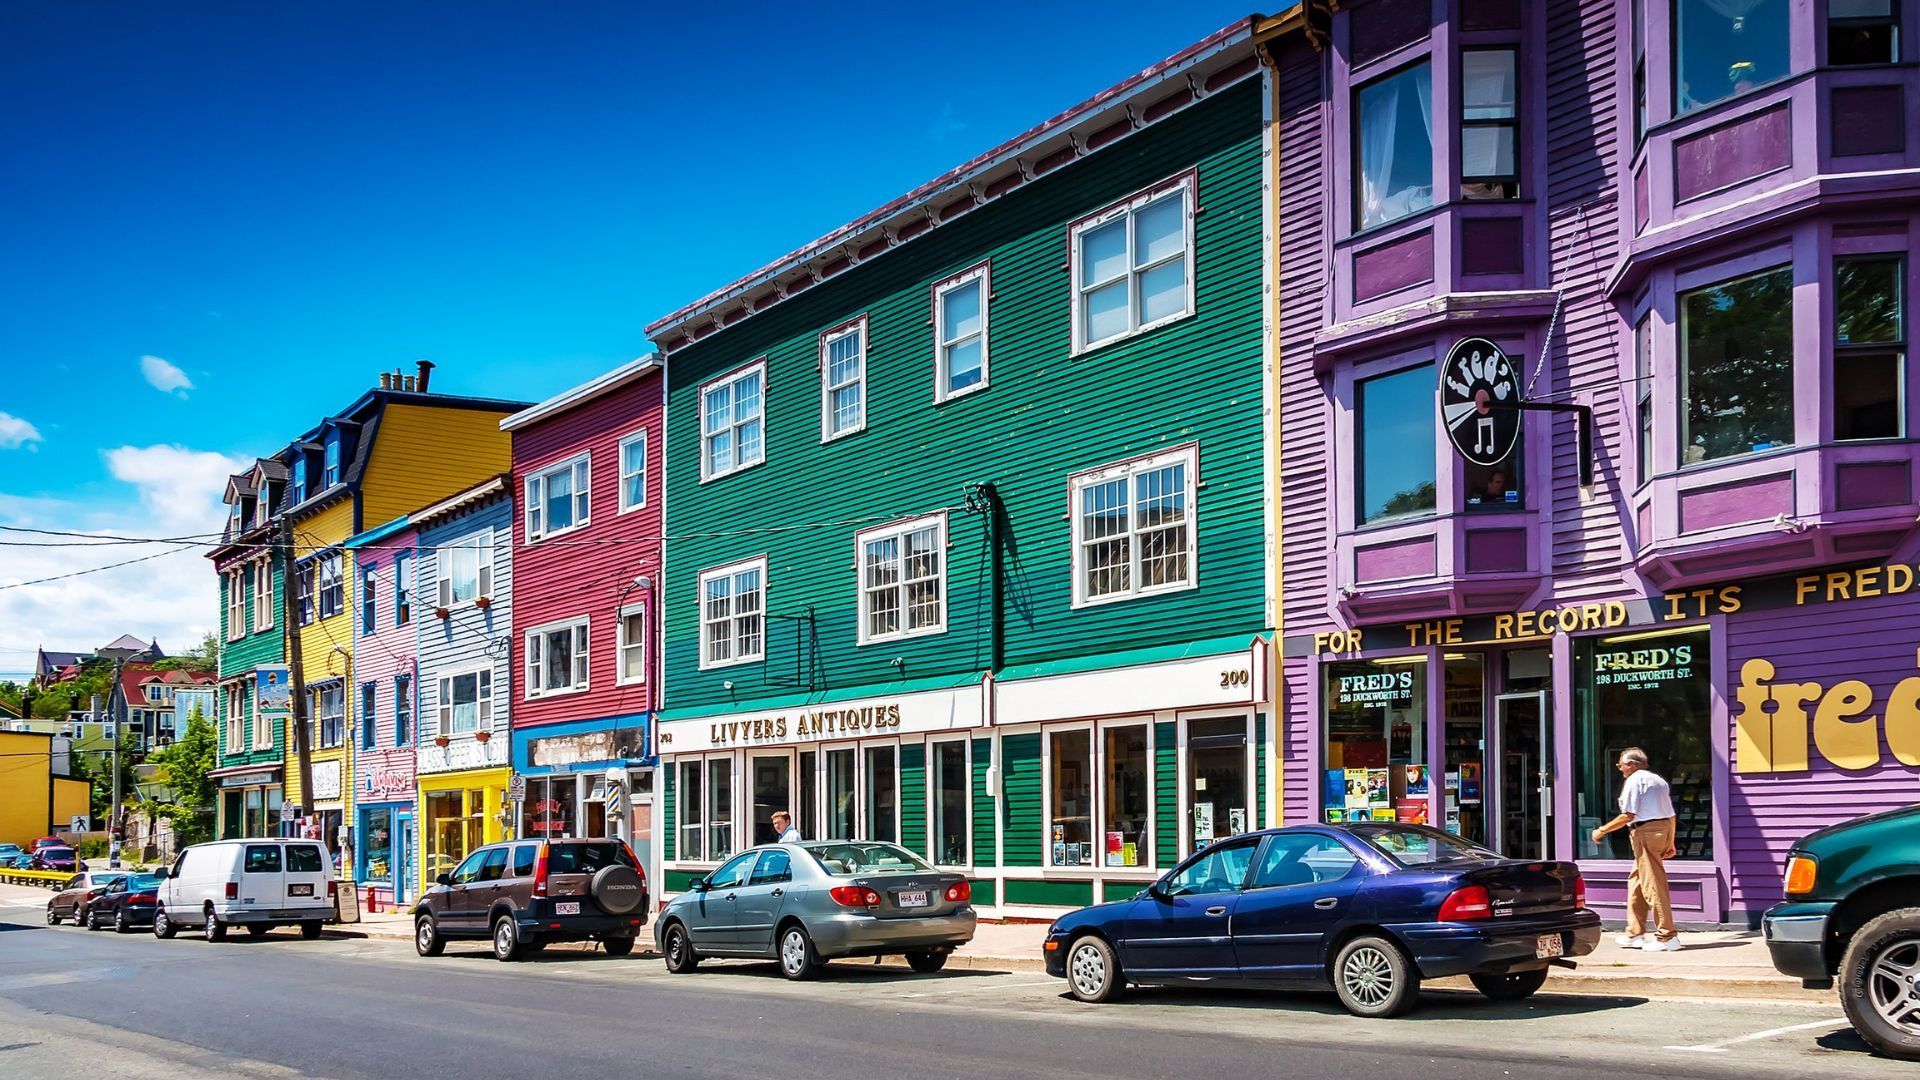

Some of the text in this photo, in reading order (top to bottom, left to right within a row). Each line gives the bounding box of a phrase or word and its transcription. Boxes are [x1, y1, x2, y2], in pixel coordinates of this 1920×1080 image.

[1447, 350, 1511, 401] fred's
[1314, 563, 1920, 655] FOR THE RECORD ITS FRED
[1594, 645, 1692, 672] FRED'S
[1220, 668, 1249, 687] 200
[1339, 671, 1412, 692] FRED'S
[1596, 667, 1693, 685] 198 DUCKWORTH ST.
[1353, 690, 1399, 702] DUCKWORTH
[1400, 689, 1413, 699] ST.
[711, 703, 900, 743] LIVYERS ANTIQUES
[914, 893, 926, 902] 644
